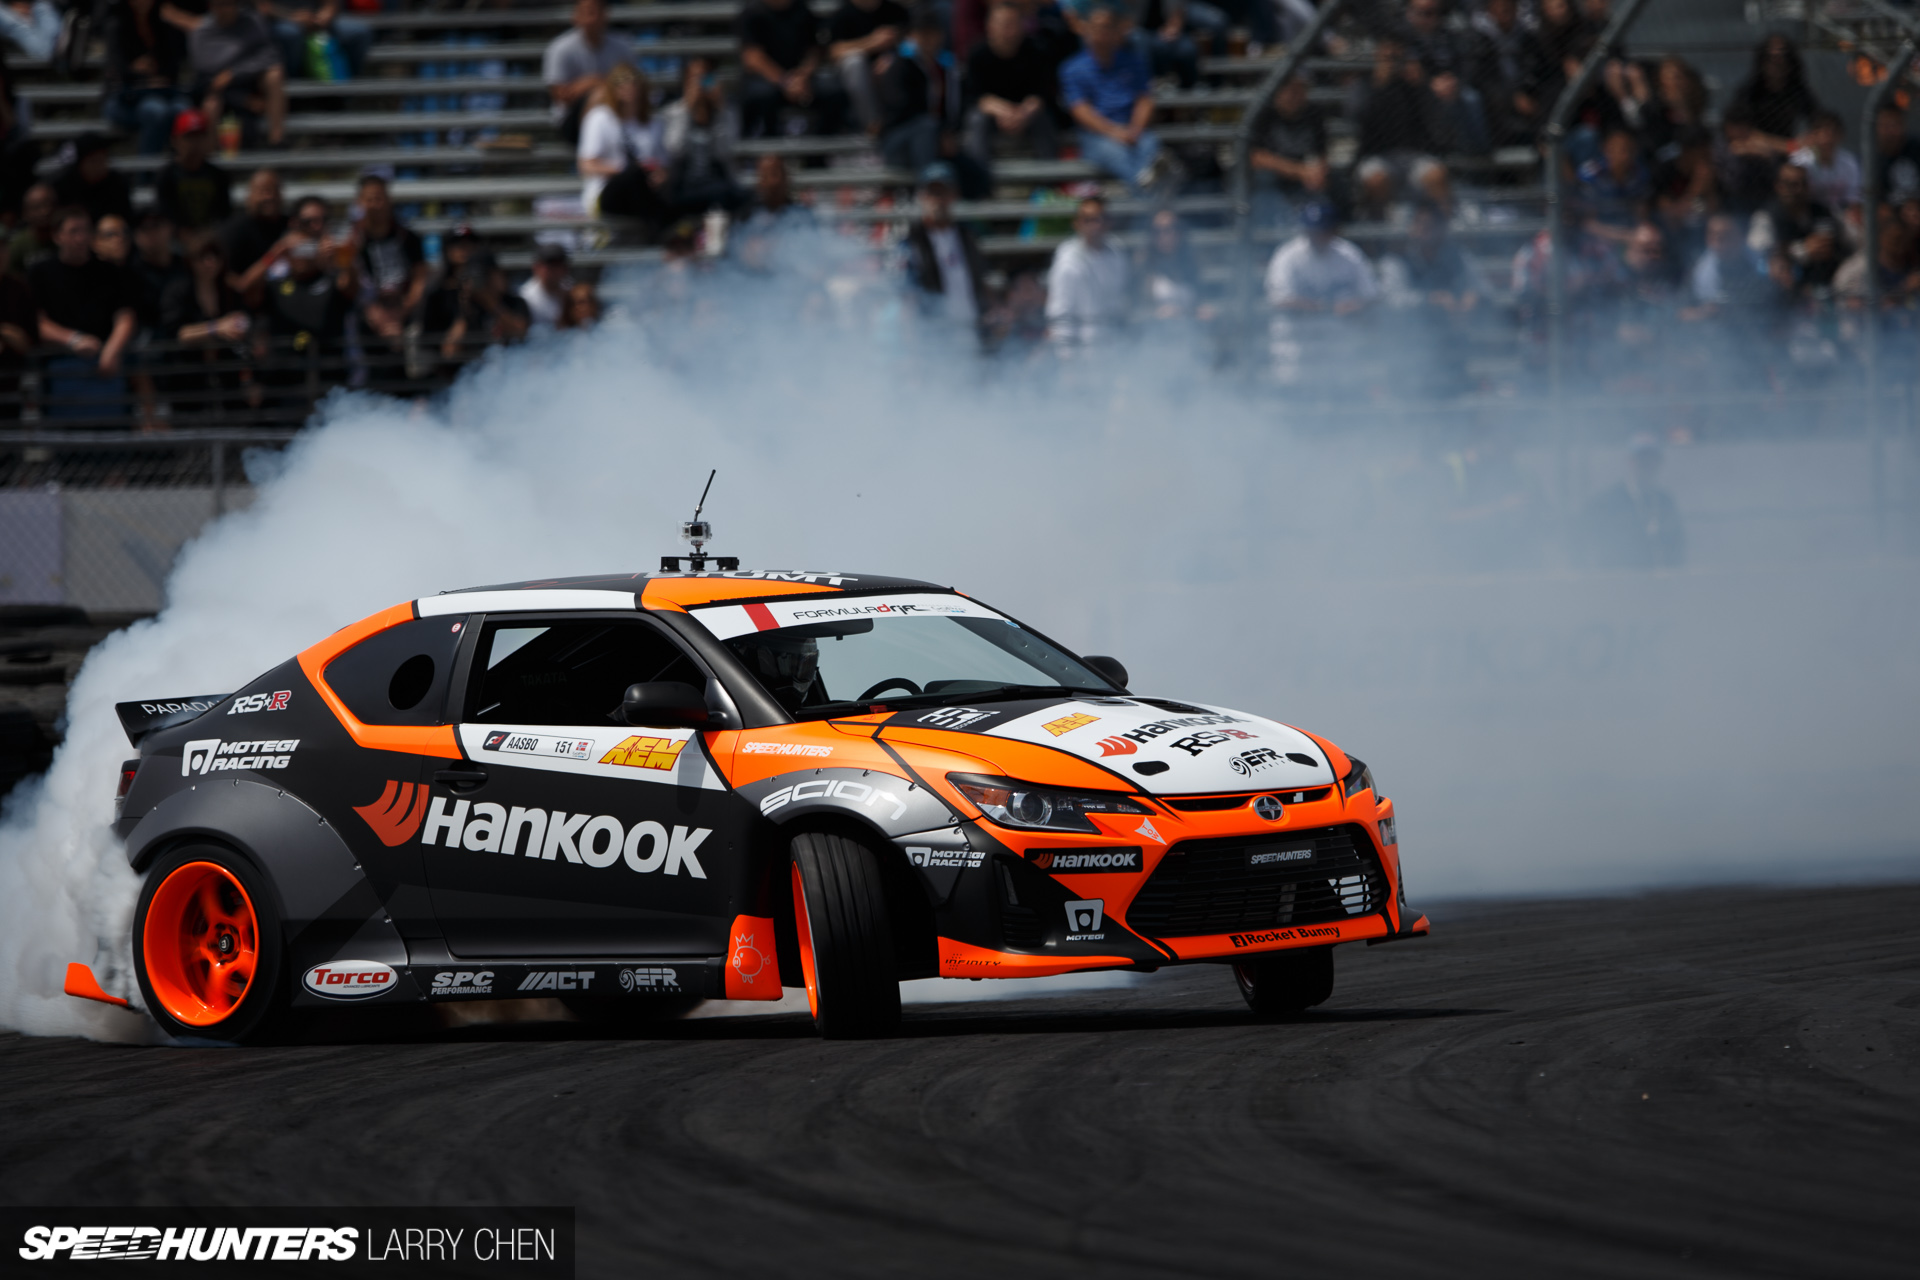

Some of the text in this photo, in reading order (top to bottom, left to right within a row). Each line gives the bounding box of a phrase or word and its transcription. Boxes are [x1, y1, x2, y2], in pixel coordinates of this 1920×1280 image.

[141, 700, 219, 715] PAPADA
[1041, 712, 1101, 737] AEM
[217, 739, 300, 755] MOTEGI
[506, 736, 573, 754] AASBO 151
[598, 735, 689, 771] AEM
[742, 742, 833, 757] SPEEDHUNTERS
[210, 756, 291, 771] RACING
[1240, 748, 1284, 767] EFR
[929, 858, 982, 868] RACING
[931, 850, 986, 860] MOTEGI
[1251, 849, 1312, 865] SPEEDHUNTERS
[1066, 933, 1105, 941] MOTEGI
[1245, 925, 1341, 945] Rocket Bunny
[313, 968, 391, 985] Torco
[431, 971, 495, 988] SPC
[634, 968, 679, 986] EFR
[431, 986, 493, 995] PERFORMANCE
